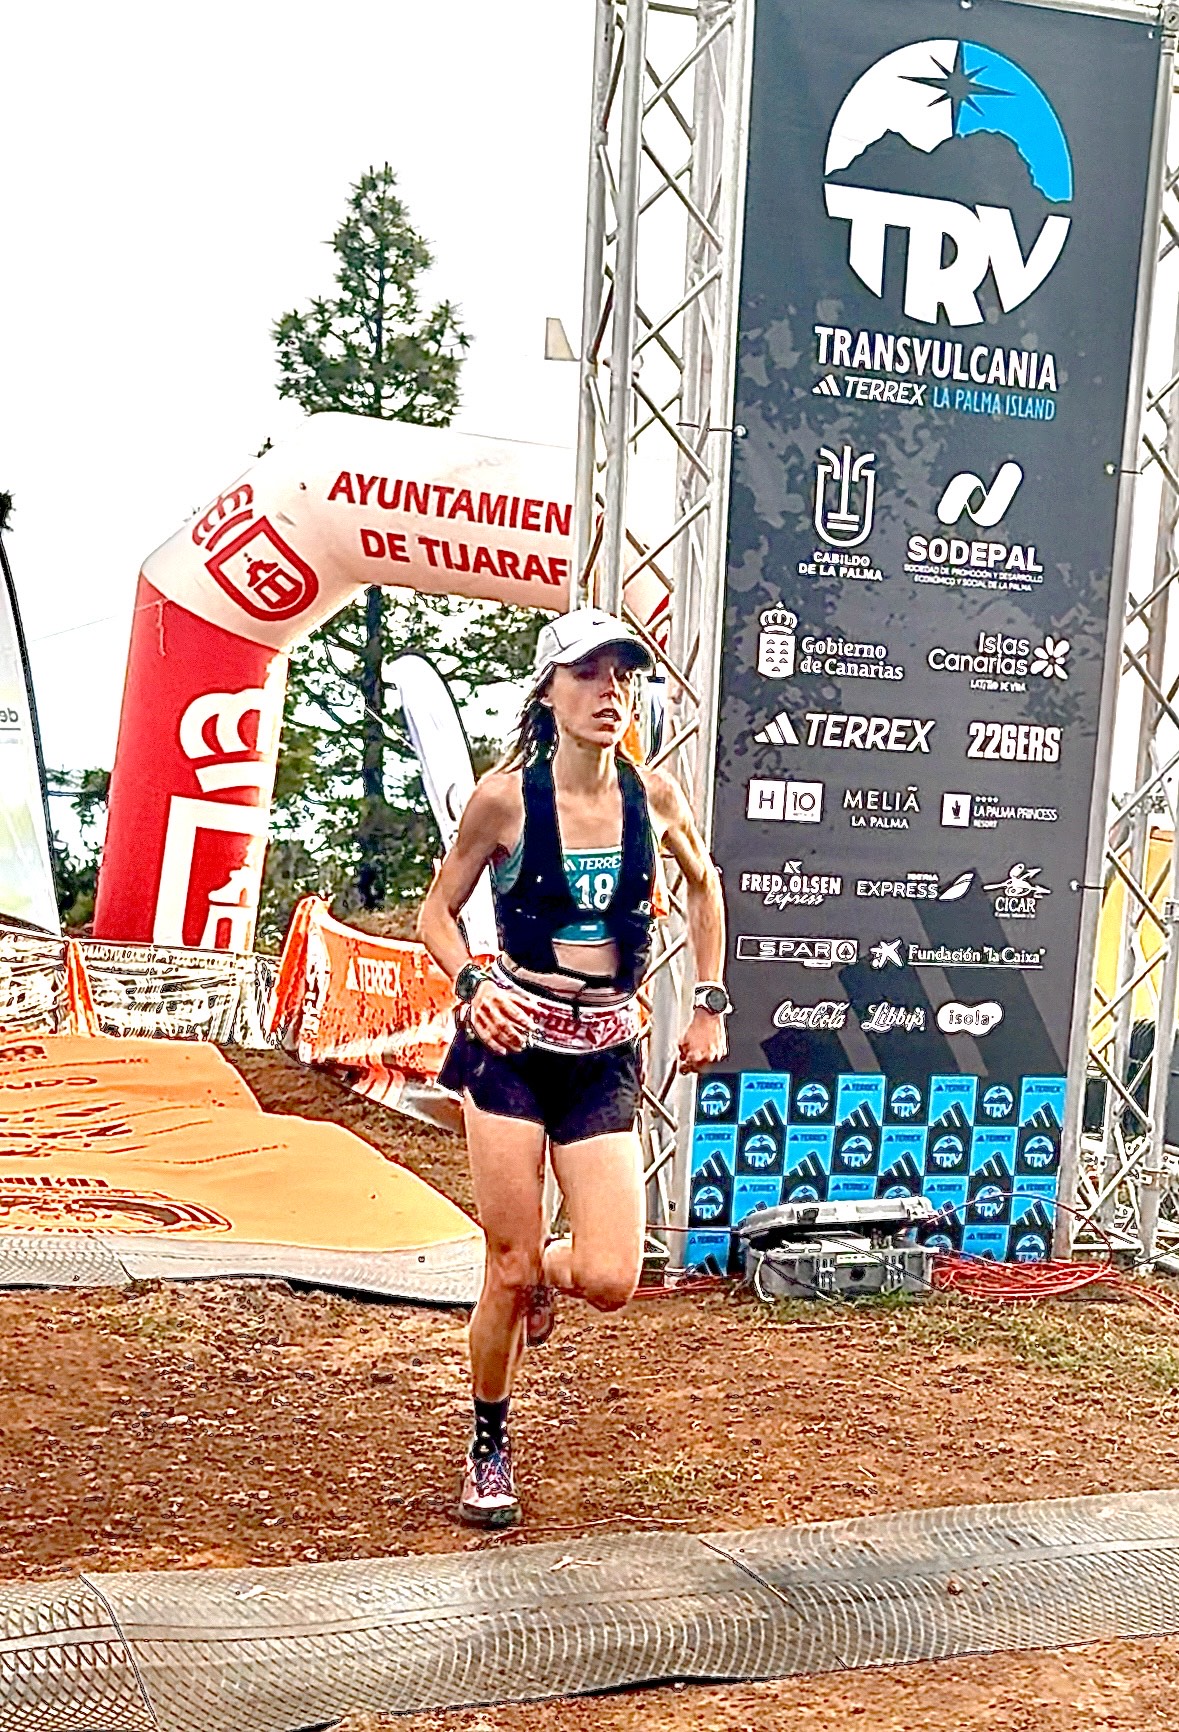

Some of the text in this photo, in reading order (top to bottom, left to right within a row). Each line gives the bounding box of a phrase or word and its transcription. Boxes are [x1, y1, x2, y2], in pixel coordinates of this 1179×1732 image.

[824, 183, 1071, 327] TRV
[814, 326, 1057, 391] TRANSVULCANIA
[844, 376, 1055, 421] TERREX LA PALMA ISLAND
[327, 471, 572, 536] AYUNTAMIEN
[359, 529, 568, 586] DE TIJARAF
[813, 551, 871, 567] CABILDO
[907, 535, 1043, 572] SODEPAL
[798, 563, 883, 581] DE LA PALMA
[801, 636, 887, 659] Gobierno
[978, 632, 1030, 656] Islas
[800, 656, 904, 680] de Canarias
[928, 648, 1028, 675] Canarias
[805, 713, 935, 752] TERREX
[967, 722, 1061, 762] 226ERS
[851, 816, 909, 829] LA PALMA
[973, 805, 1058, 821] LA PALMA PRINCESS
[578, 855, 622, 871] TERRE
[575, 872, 615, 911] 18
[763, 889, 824, 911] Express
[856, 880, 939, 899] EXPRESS
[995, 897, 1036, 913] CICAR
[758, 941, 831, 958] SPAR
[908, 944, 981, 963] Fundación
[357, 957, 403, 998] TERREX
